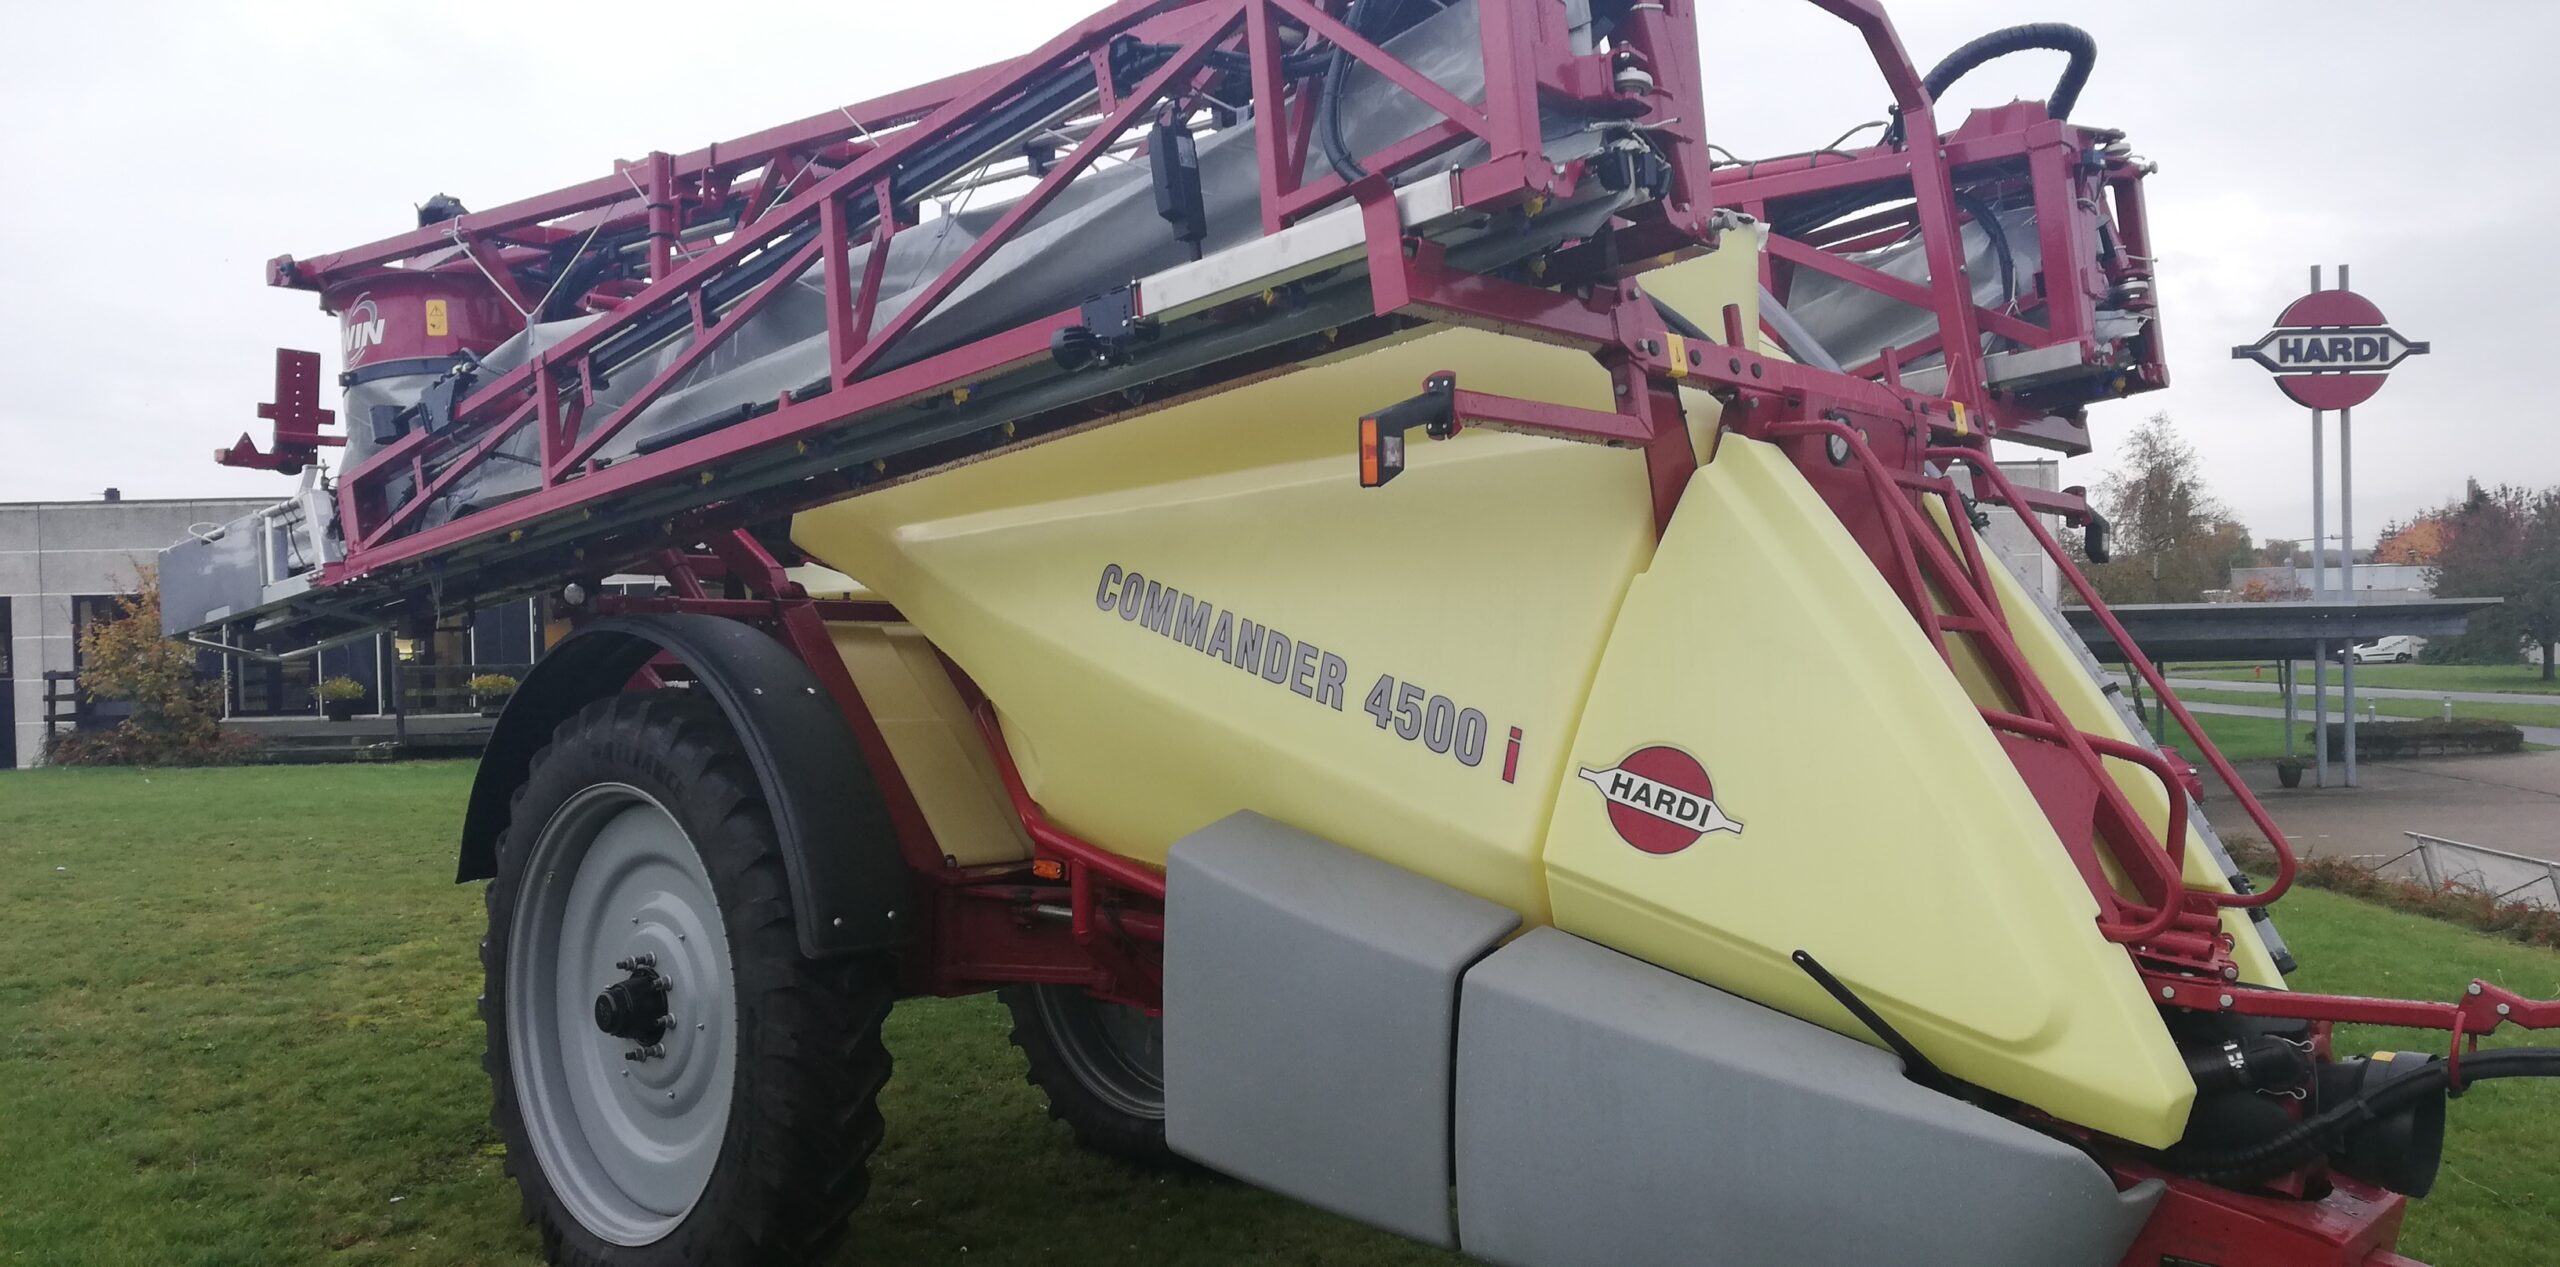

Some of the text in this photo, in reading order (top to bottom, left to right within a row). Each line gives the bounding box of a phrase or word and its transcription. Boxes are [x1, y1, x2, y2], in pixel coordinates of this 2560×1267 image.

[2279, 336, 2389, 362] HARDI
[1096, 563, 1523, 784] COMMANDER 4500 i
[1609, 773, 1711, 828] HARDI
